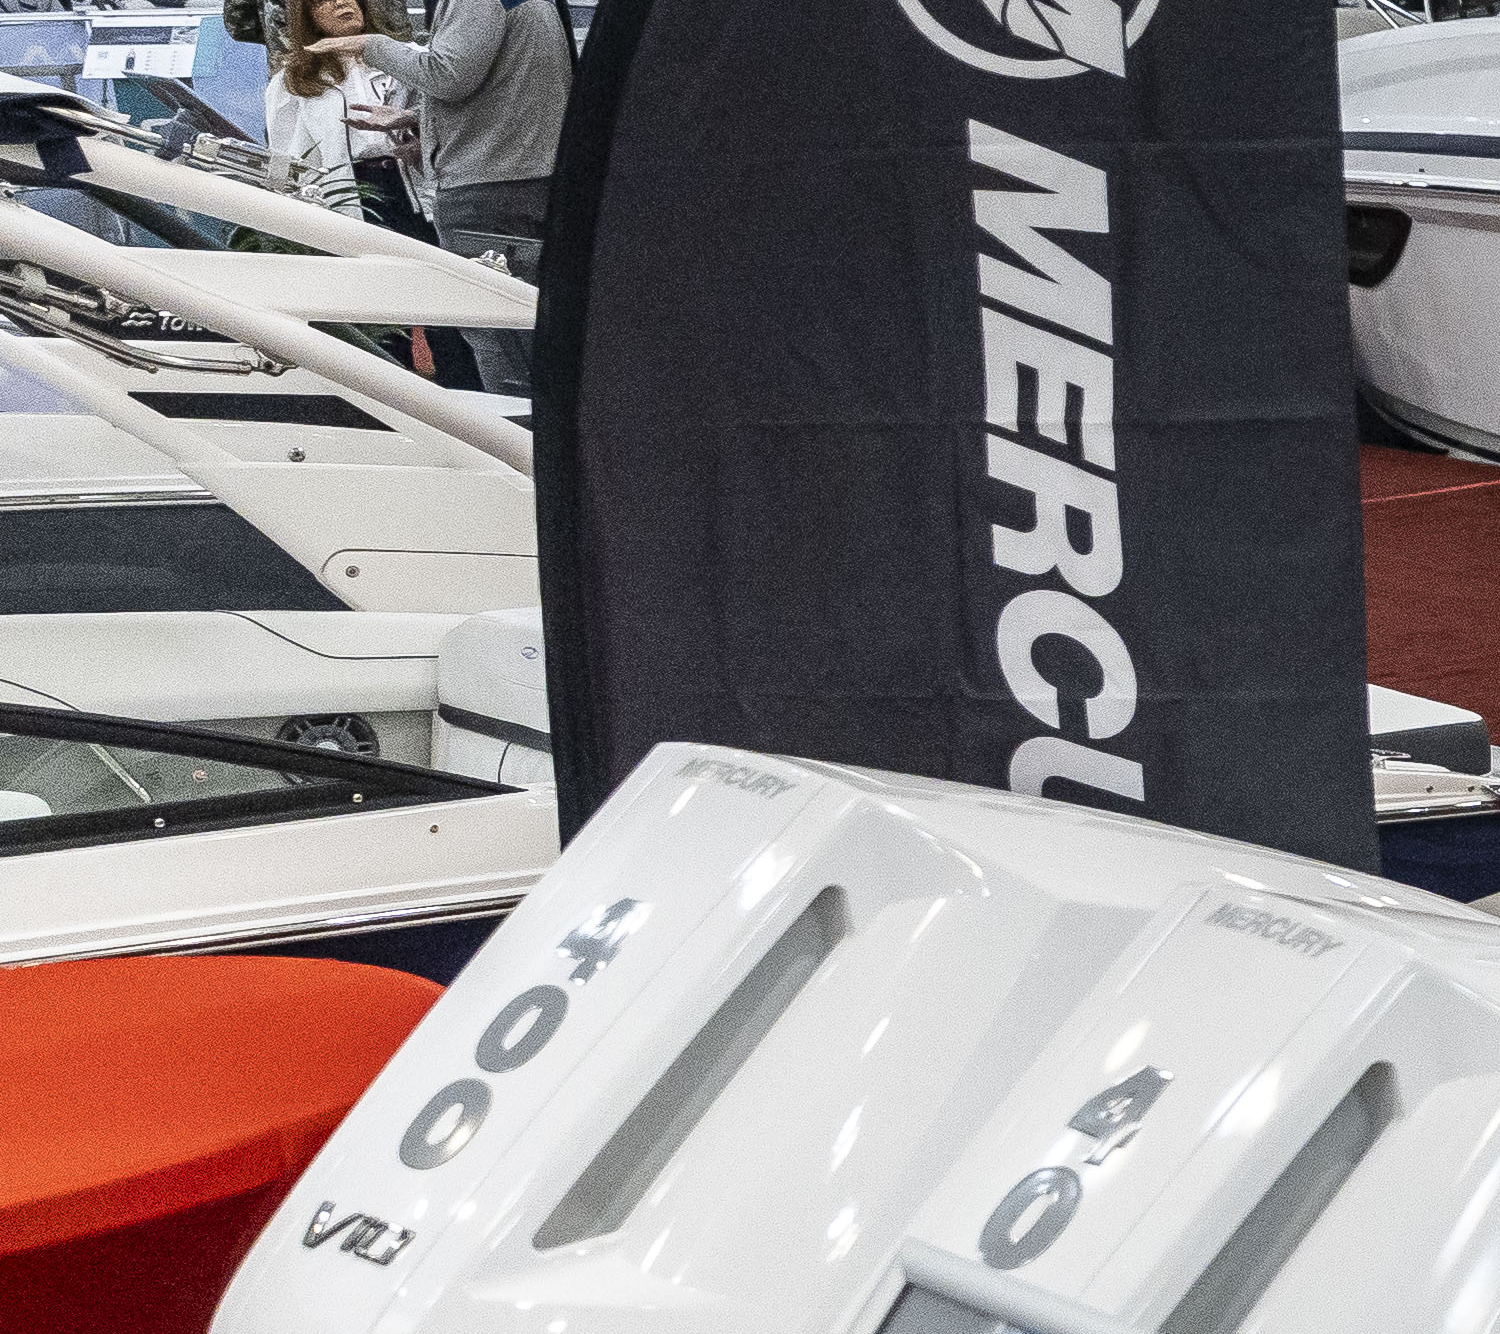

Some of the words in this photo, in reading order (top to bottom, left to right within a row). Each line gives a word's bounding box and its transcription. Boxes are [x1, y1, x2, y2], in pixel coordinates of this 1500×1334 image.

[675, 755, 798, 802] MERCURY
[1204, 900, 1346, 961] MERCURY
[977, 1065, 1176, 1270] 40
